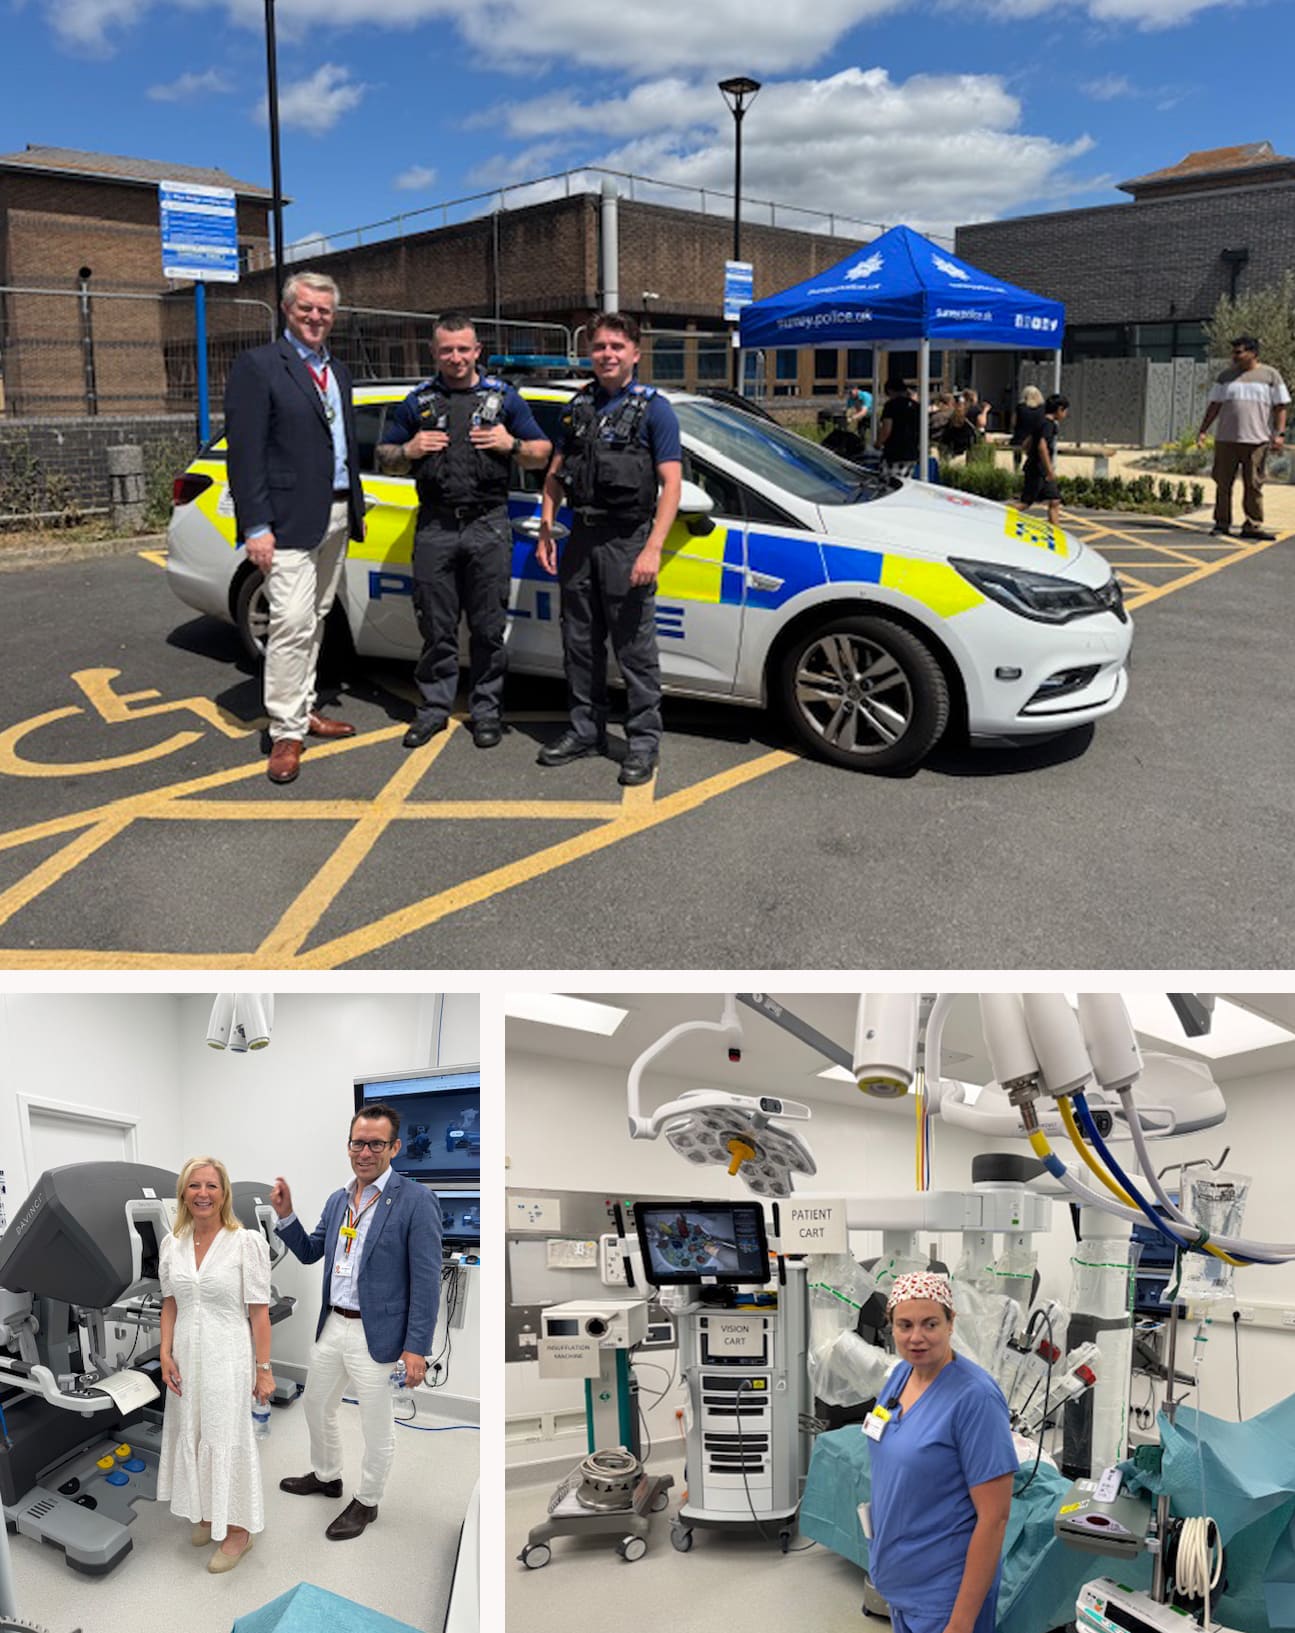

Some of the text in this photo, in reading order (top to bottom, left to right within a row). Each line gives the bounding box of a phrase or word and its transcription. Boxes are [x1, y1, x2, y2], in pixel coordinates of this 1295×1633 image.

[791, 1208, 832, 1220] PATIENT
[799, 1227, 824, 1238] CART
[720, 1325, 749, 1333] VISION
[724, 1337, 745, 1345] CART
